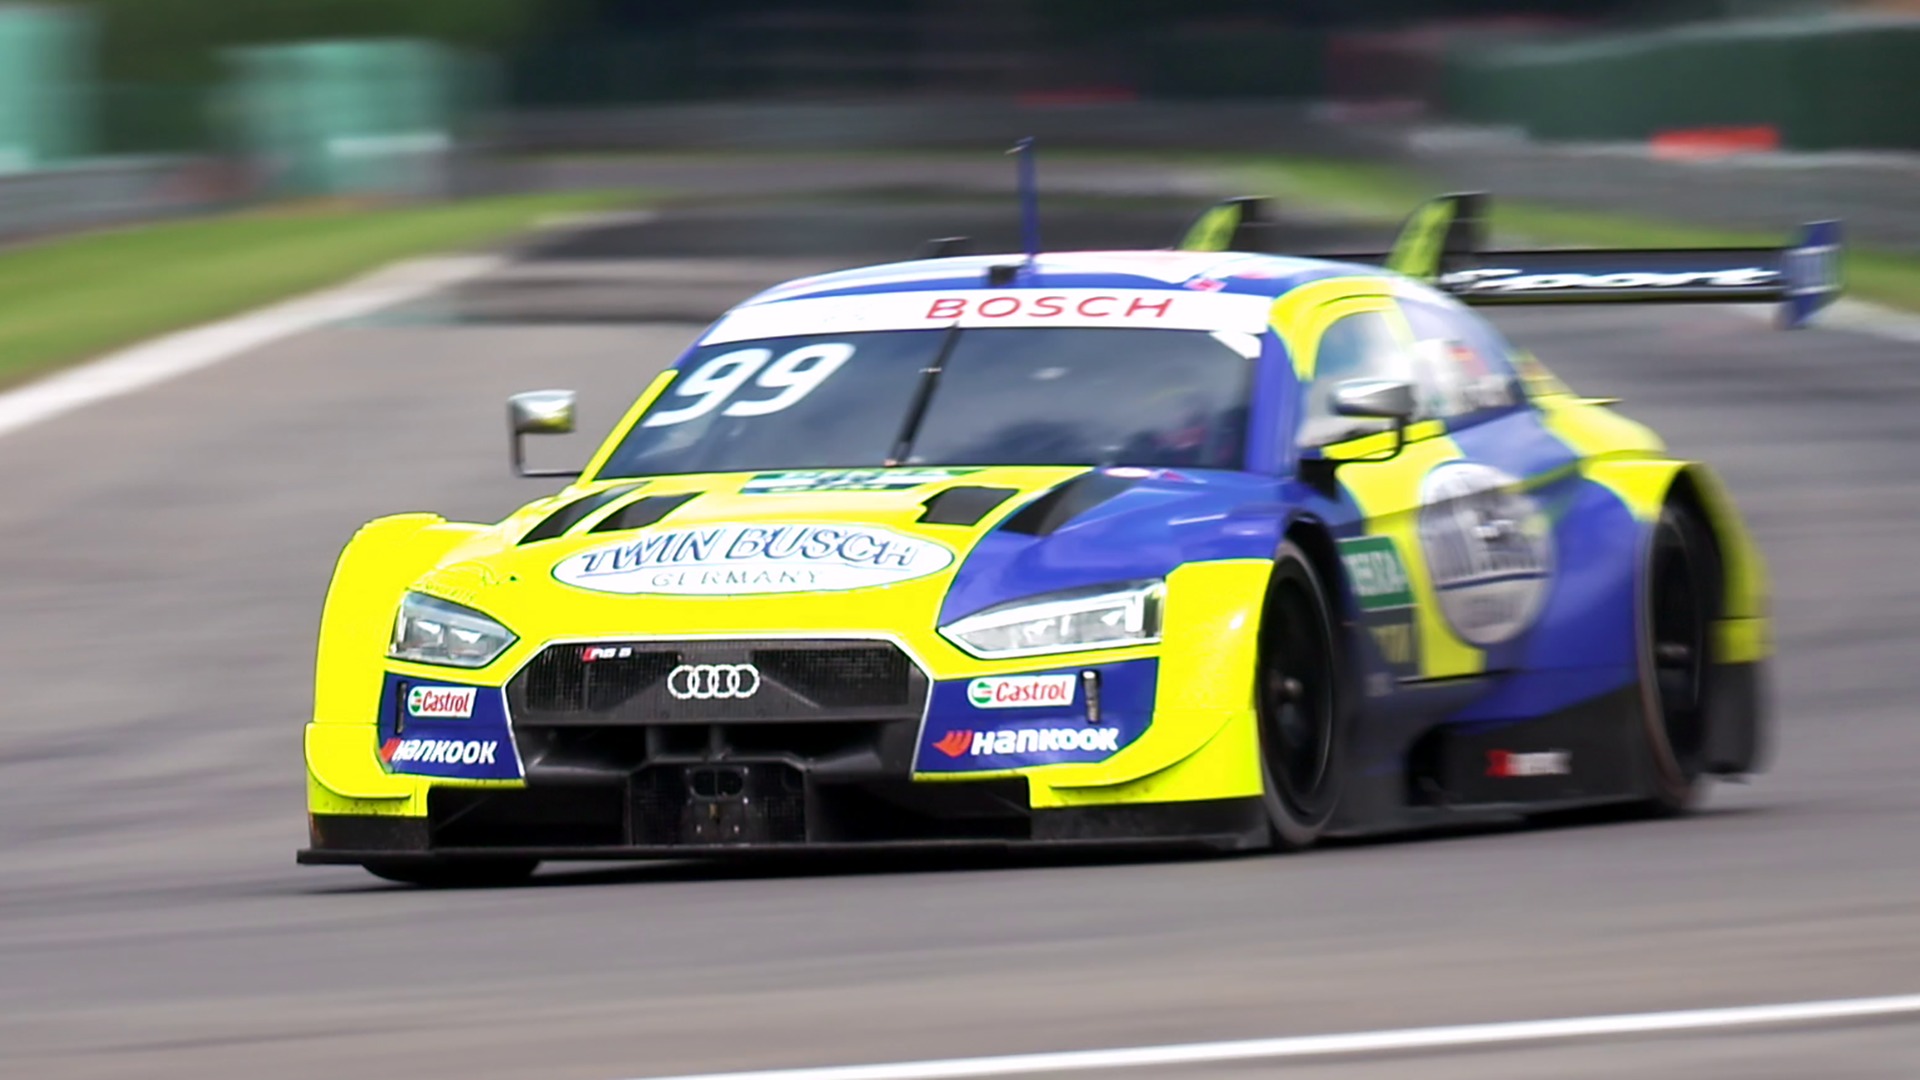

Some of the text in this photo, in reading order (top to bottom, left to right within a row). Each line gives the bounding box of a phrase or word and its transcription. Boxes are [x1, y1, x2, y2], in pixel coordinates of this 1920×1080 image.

[925, 296, 1174, 319] BOSCH
[641, 342, 857, 428] 99
[583, 525, 922, 572] TWIN BUSCH
[651, 570, 823, 587] GERMANY
[422, 690, 470, 713] Castrol
[996, 680, 1067, 702] Castrol
